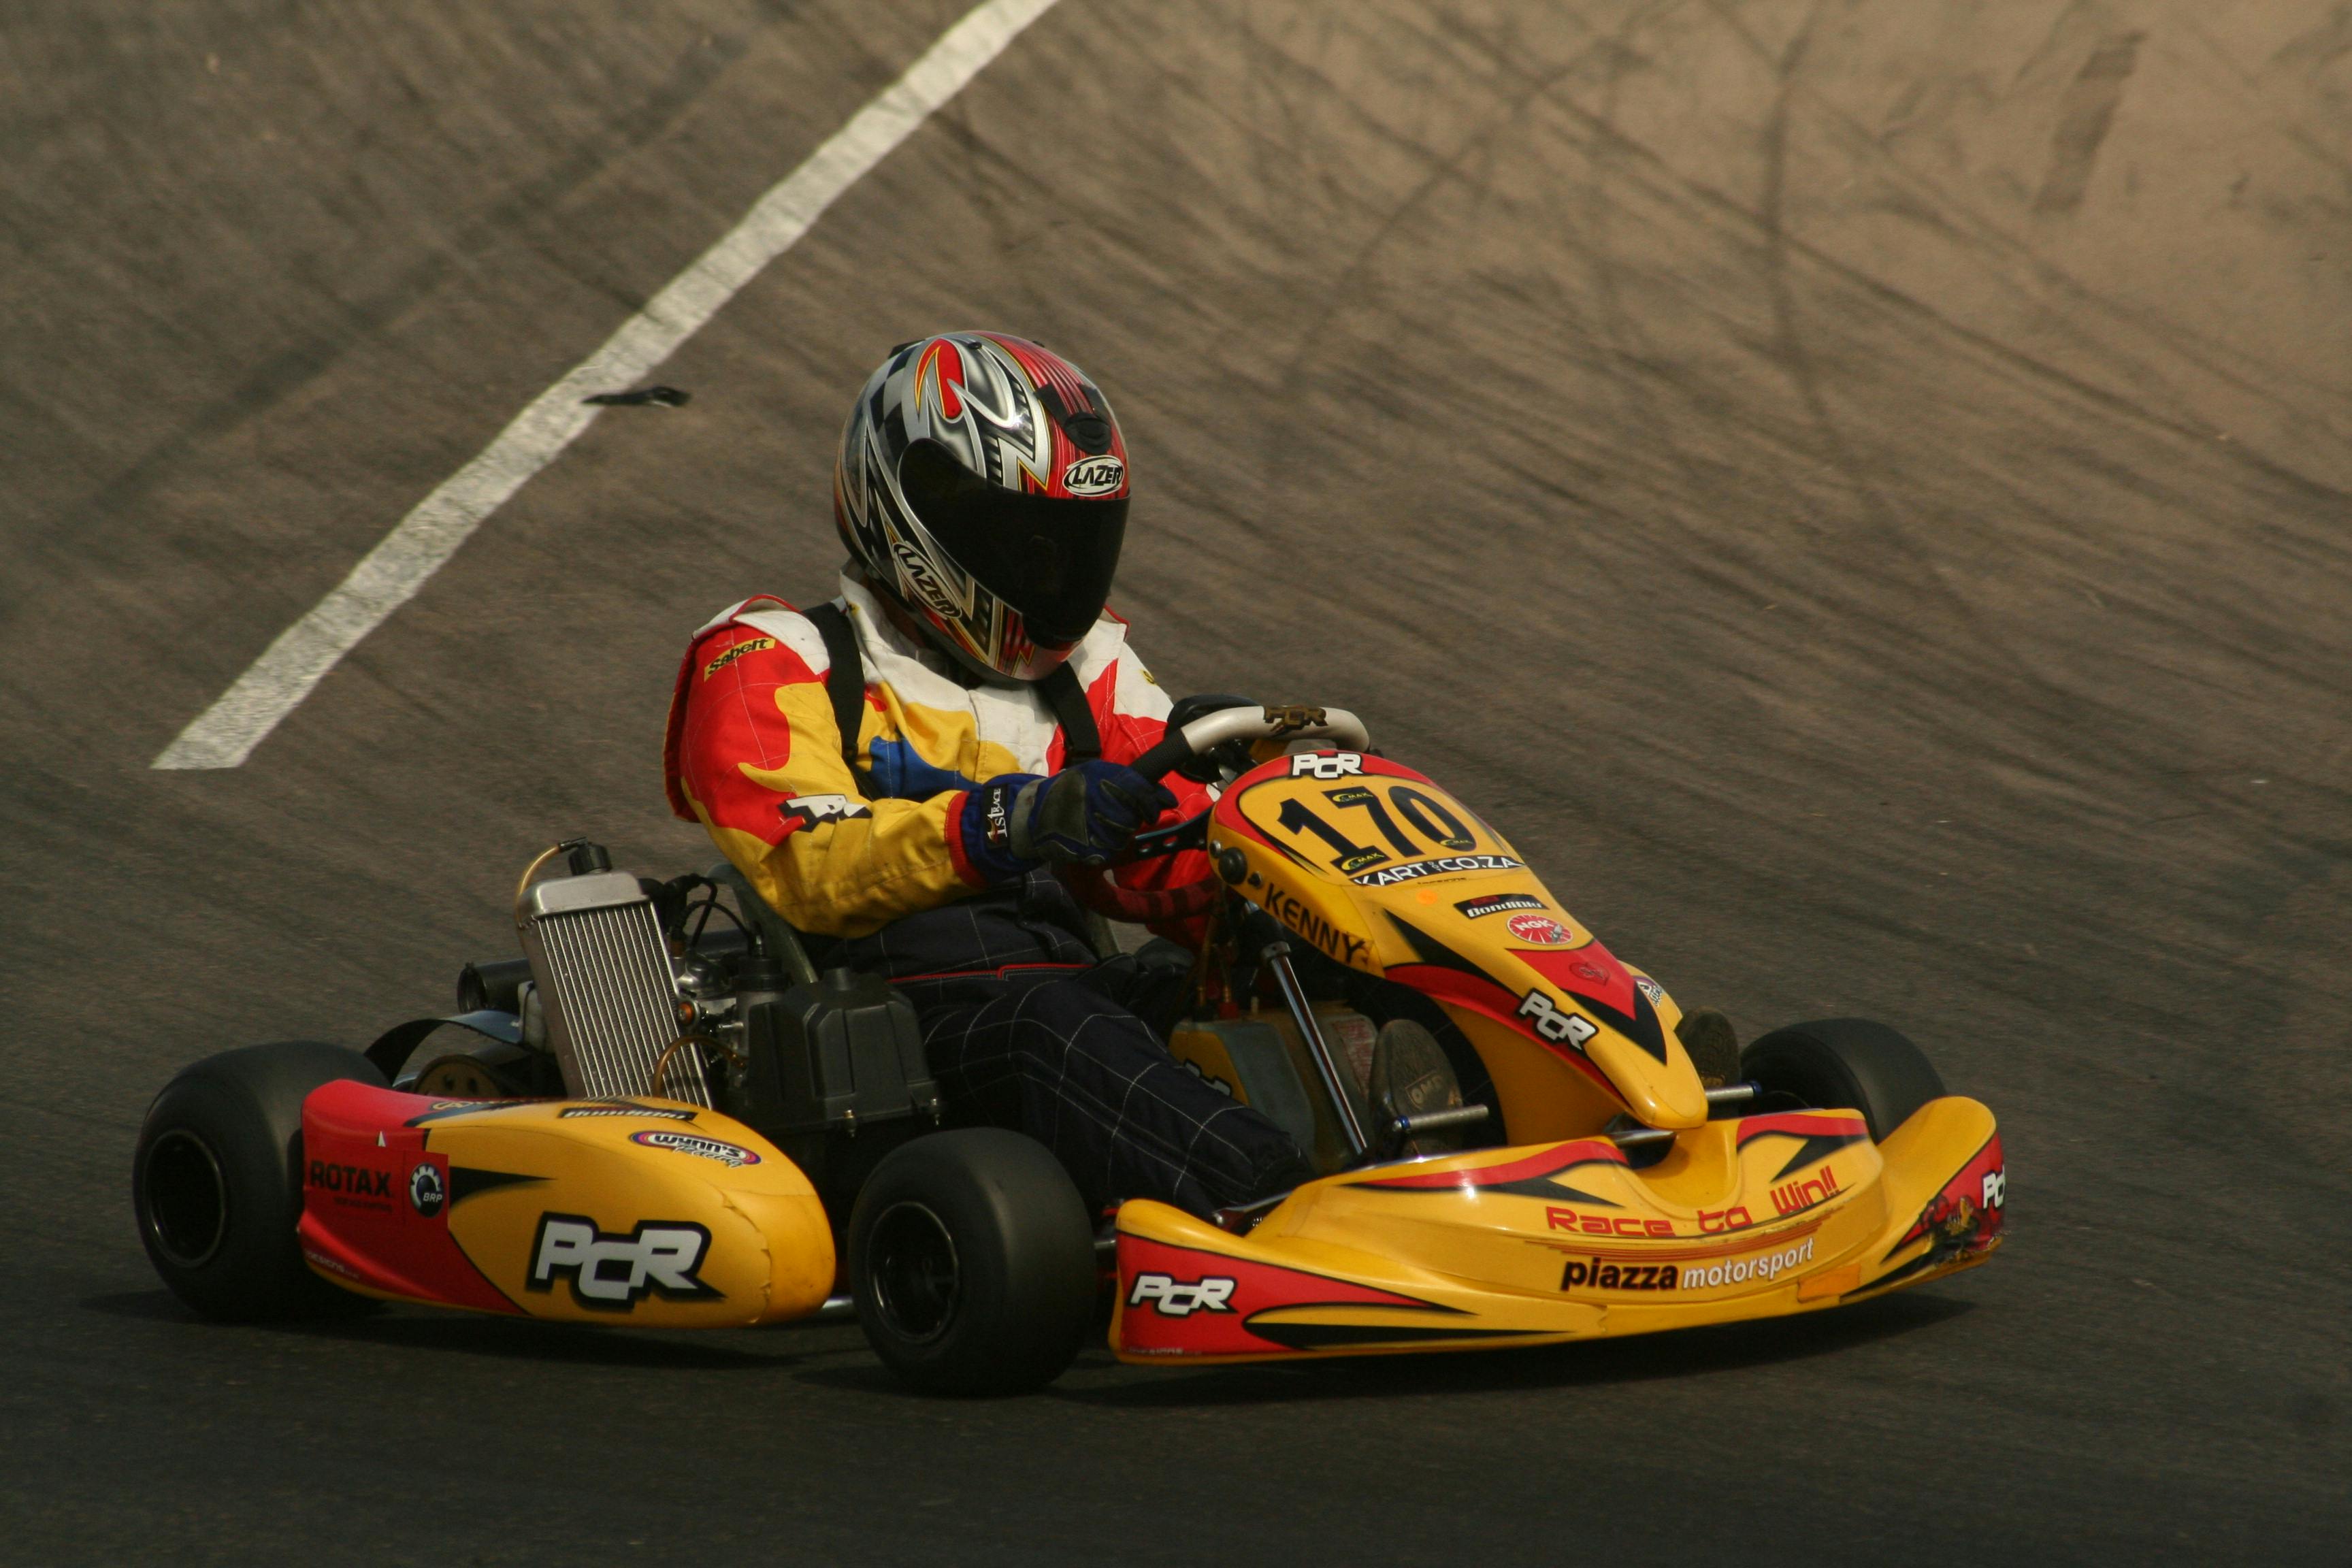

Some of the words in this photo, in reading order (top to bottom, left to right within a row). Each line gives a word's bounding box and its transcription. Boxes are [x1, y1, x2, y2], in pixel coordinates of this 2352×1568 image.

[1073, 459, 1124, 486] LAZER
[899, 546, 960, 615] LAZER
[708, 639, 768, 674] Sabelt
[1292, 753, 1363, 779] PCR
[1278, 785, 1477, 877] 170
[1354, 862, 1428, 887] KART
[1264, 883, 1365, 963] KENNY
[1515, 919, 1554, 931] NGK
[1518, 991, 1597, 1050] PCR
[310, 1160, 392, 1198] ROTAX
[423, 1192, 443, 1203] BRP
[1983, 1164, 2006, 1209] PC
[1546, 1207, 1676, 1237] Race
[1698, 1207, 1752, 1234] to
[1770, 1166, 1840, 1213] Win!!
[534, 1220, 708, 1301] PCR
[1561, 1256, 1678, 1292] piazza
[1682, 1237, 1815, 1288] motorsport
[1130, 1275, 1234, 1315] PCR
